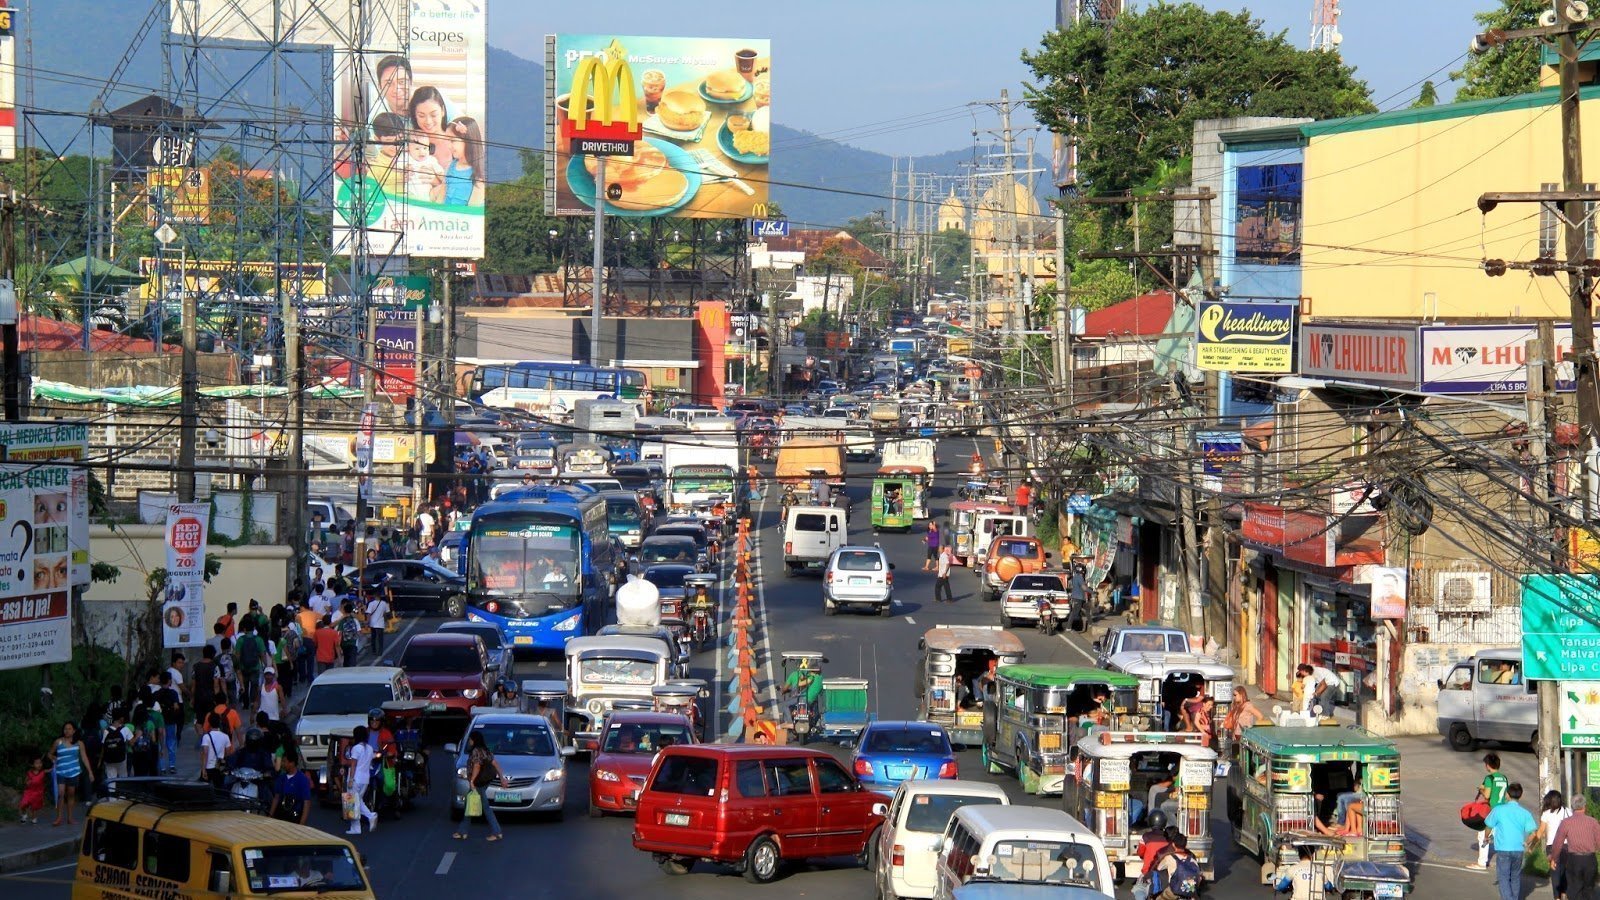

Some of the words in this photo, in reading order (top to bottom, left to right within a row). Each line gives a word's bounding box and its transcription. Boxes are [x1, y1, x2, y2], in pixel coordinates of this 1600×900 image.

[411, 26, 465, 46] Scapes
[628, 54, 680, 65] McSaver
[418, 216, 470, 232] Amaia
[758, 222, 785, 232] JKJ
[1222, 308, 1291, 333] headliners
[383, 352, 415, 360] STORE
[1334, 334, 1408, 375] LHUILLIER
[16, 427, 54, 445] MEDICAL
[56, 424, 86, 442] CENTER
[26, 467, 69, 489] CENTER
[175, 523, 200, 532] RED
[175, 532, 199, 541] HOT
[174, 540, 200, 549] SALE
[22, 596, 34, 619] ka
[34, 593, 52, 619] pa!
[43, 629, 58, 638] CITY
[1561, 649, 1600, 659] Malvar
[1561, 661, 1586, 674] Lipa
